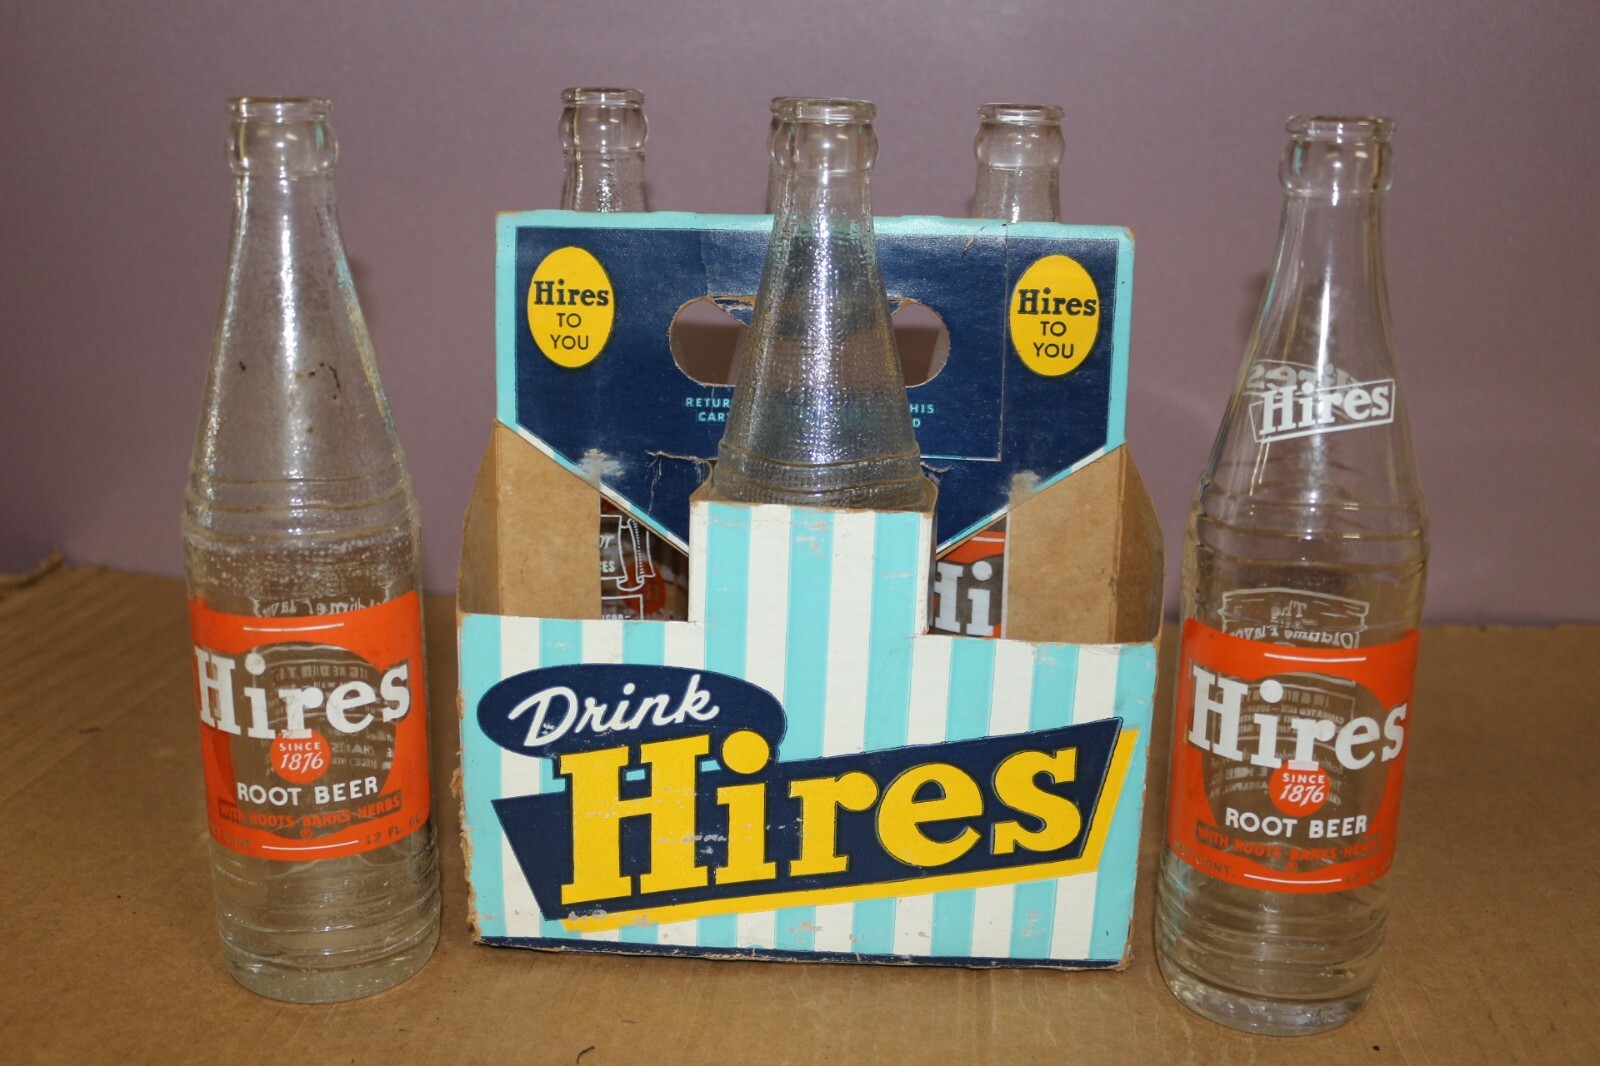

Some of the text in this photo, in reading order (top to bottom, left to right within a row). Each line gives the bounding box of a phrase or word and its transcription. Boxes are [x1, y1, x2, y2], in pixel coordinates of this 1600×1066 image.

[533, 278, 609, 306] Hires
[1017, 287, 1097, 316] Hires
[556, 312, 582, 328] TO
[1040, 321, 1067, 337] TO
[550, 334, 589, 350] YOU
[1033, 342, 1075, 359] YOU
[685, 397, 935, 414] RETUR HIS
[698, 411, 729, 422] CAR
[1258, 382, 1390, 436] Hires
[194, 646, 411, 739] Hires
[508, 674, 721, 747] Drink
[1188, 665, 1408, 771] Hires
[279, 742, 321, 752] SINCE
[281, 752, 324, 774] 1876
[1282, 773, 1325, 784] SINCE
[237, 776, 378, 806] ROOT BEER
[1279, 783, 1325, 807] 1876
[357, 794, 400, 818] HERBS
[560, 730, 1083, 905] Hires
[1225, 806, 1367, 839] ROOT BEER
